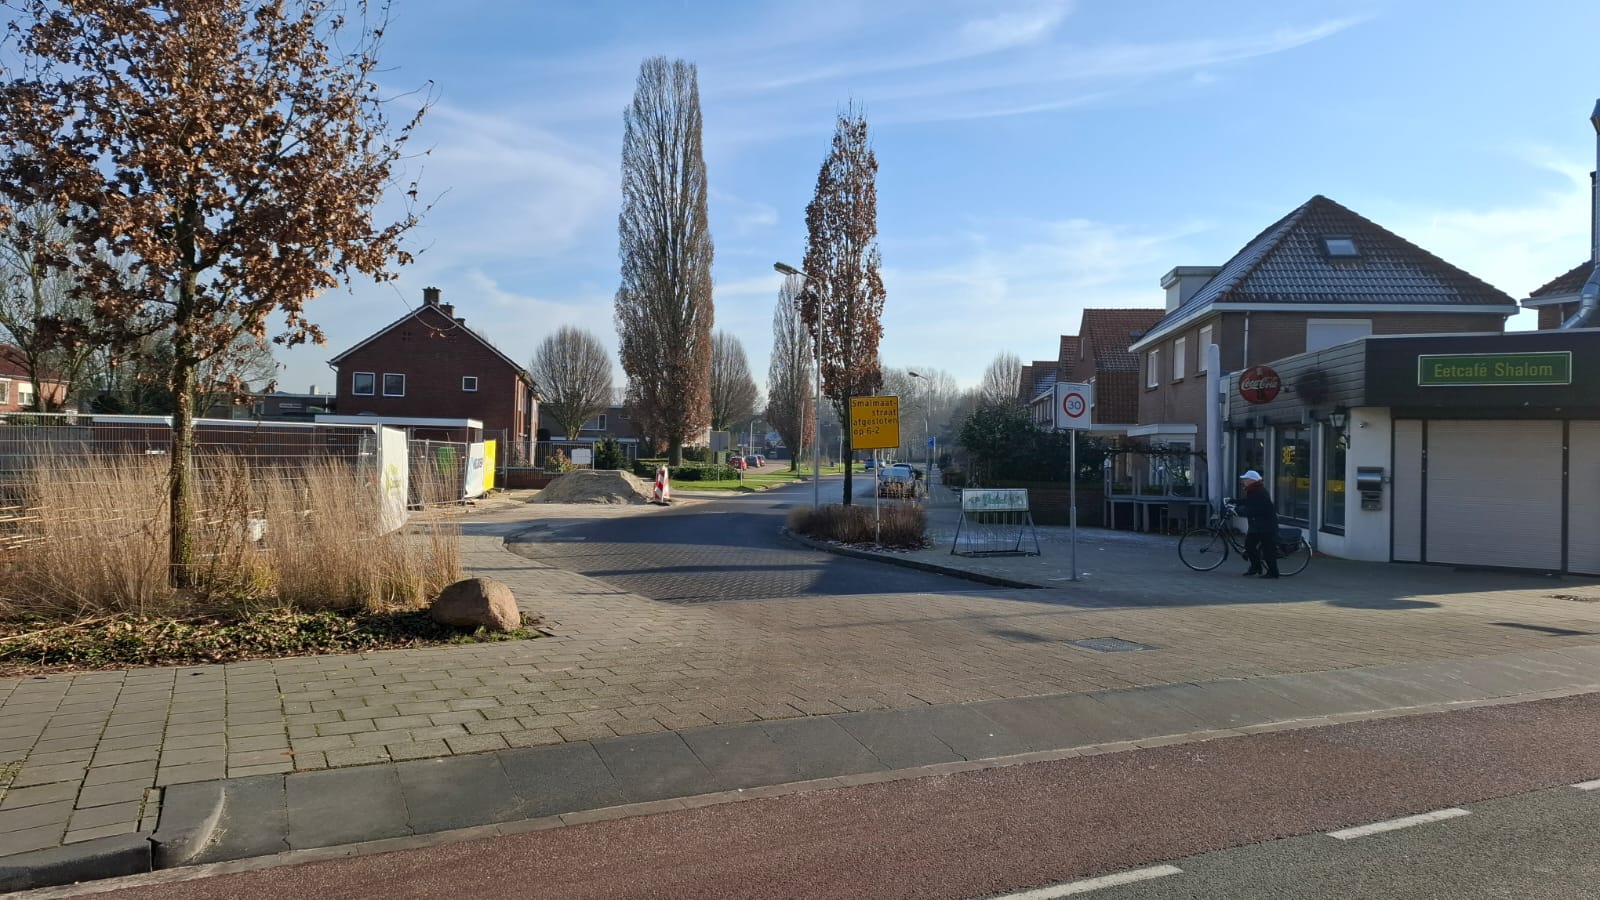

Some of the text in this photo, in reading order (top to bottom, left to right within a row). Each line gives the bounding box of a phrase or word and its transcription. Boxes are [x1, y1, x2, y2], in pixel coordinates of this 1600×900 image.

[1434, 362, 1553, 377] Eetcafé Shalom
[1068, 400, 1082, 410] 30
[853, 417, 898, 427] afgesloten
